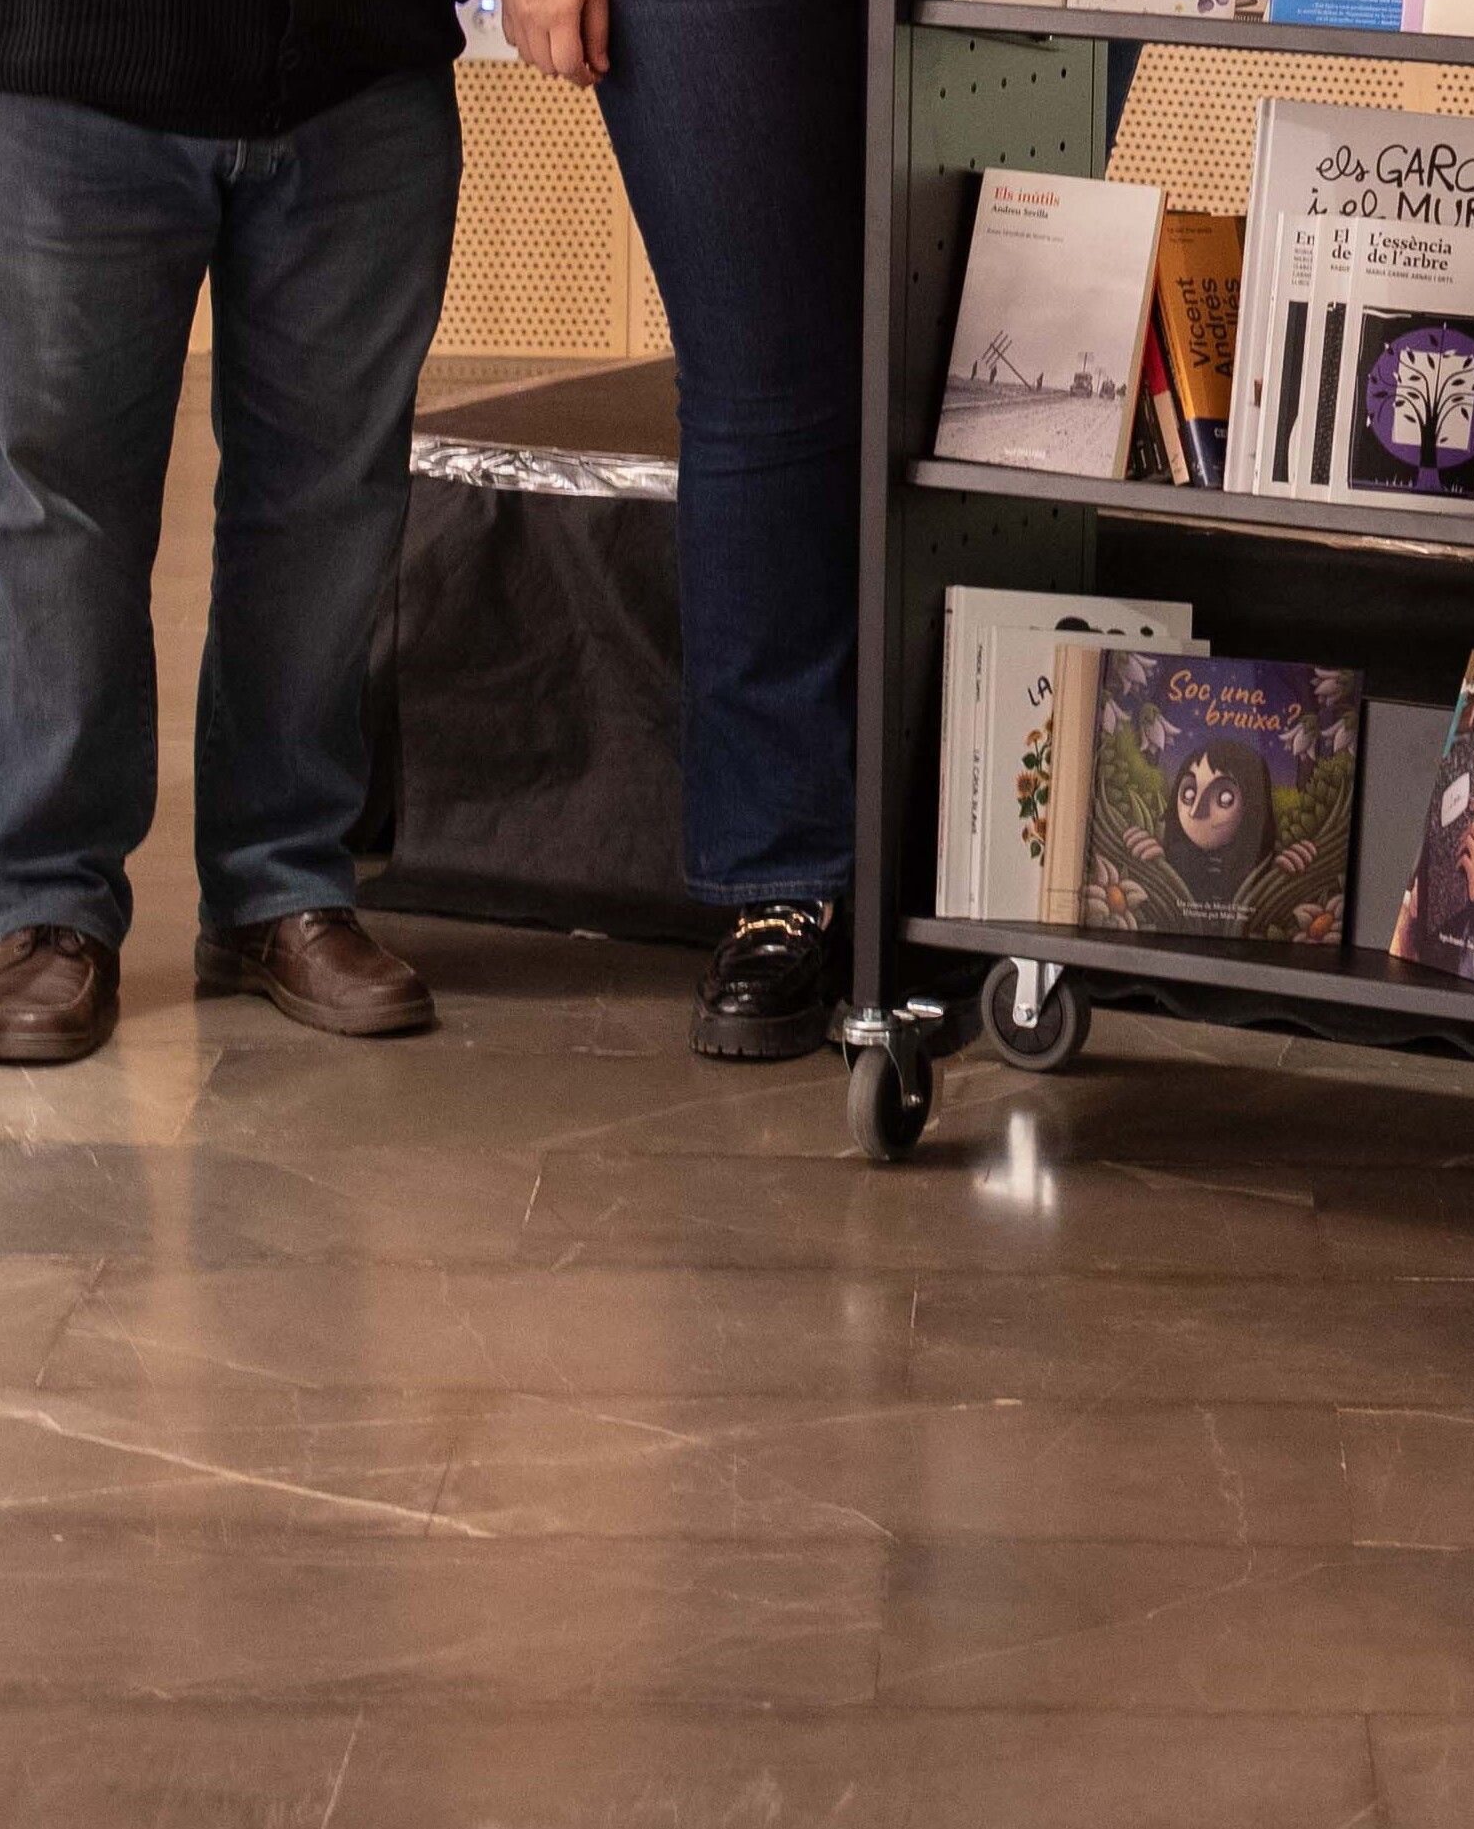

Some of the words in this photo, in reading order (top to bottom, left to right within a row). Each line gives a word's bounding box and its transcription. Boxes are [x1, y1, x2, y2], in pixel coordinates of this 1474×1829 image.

[1316, 145, 1370, 183] els
[994, 185, 1014, 201] Els
[1367, 249, 1388, 265] de
[1392, 249, 1449, 271] l'arbre
[1369, 232, 1453, 255] L'essència
[1176, 277, 1209, 369] Vicent
[1201, 276, 1233, 379] Andrés
[1028, 676, 1054, 707] LA
[1168, 669, 1211, 702] Soc
[1220, 686, 1266, 705] una
[1206, 698, 1302, 731] bruixa?
